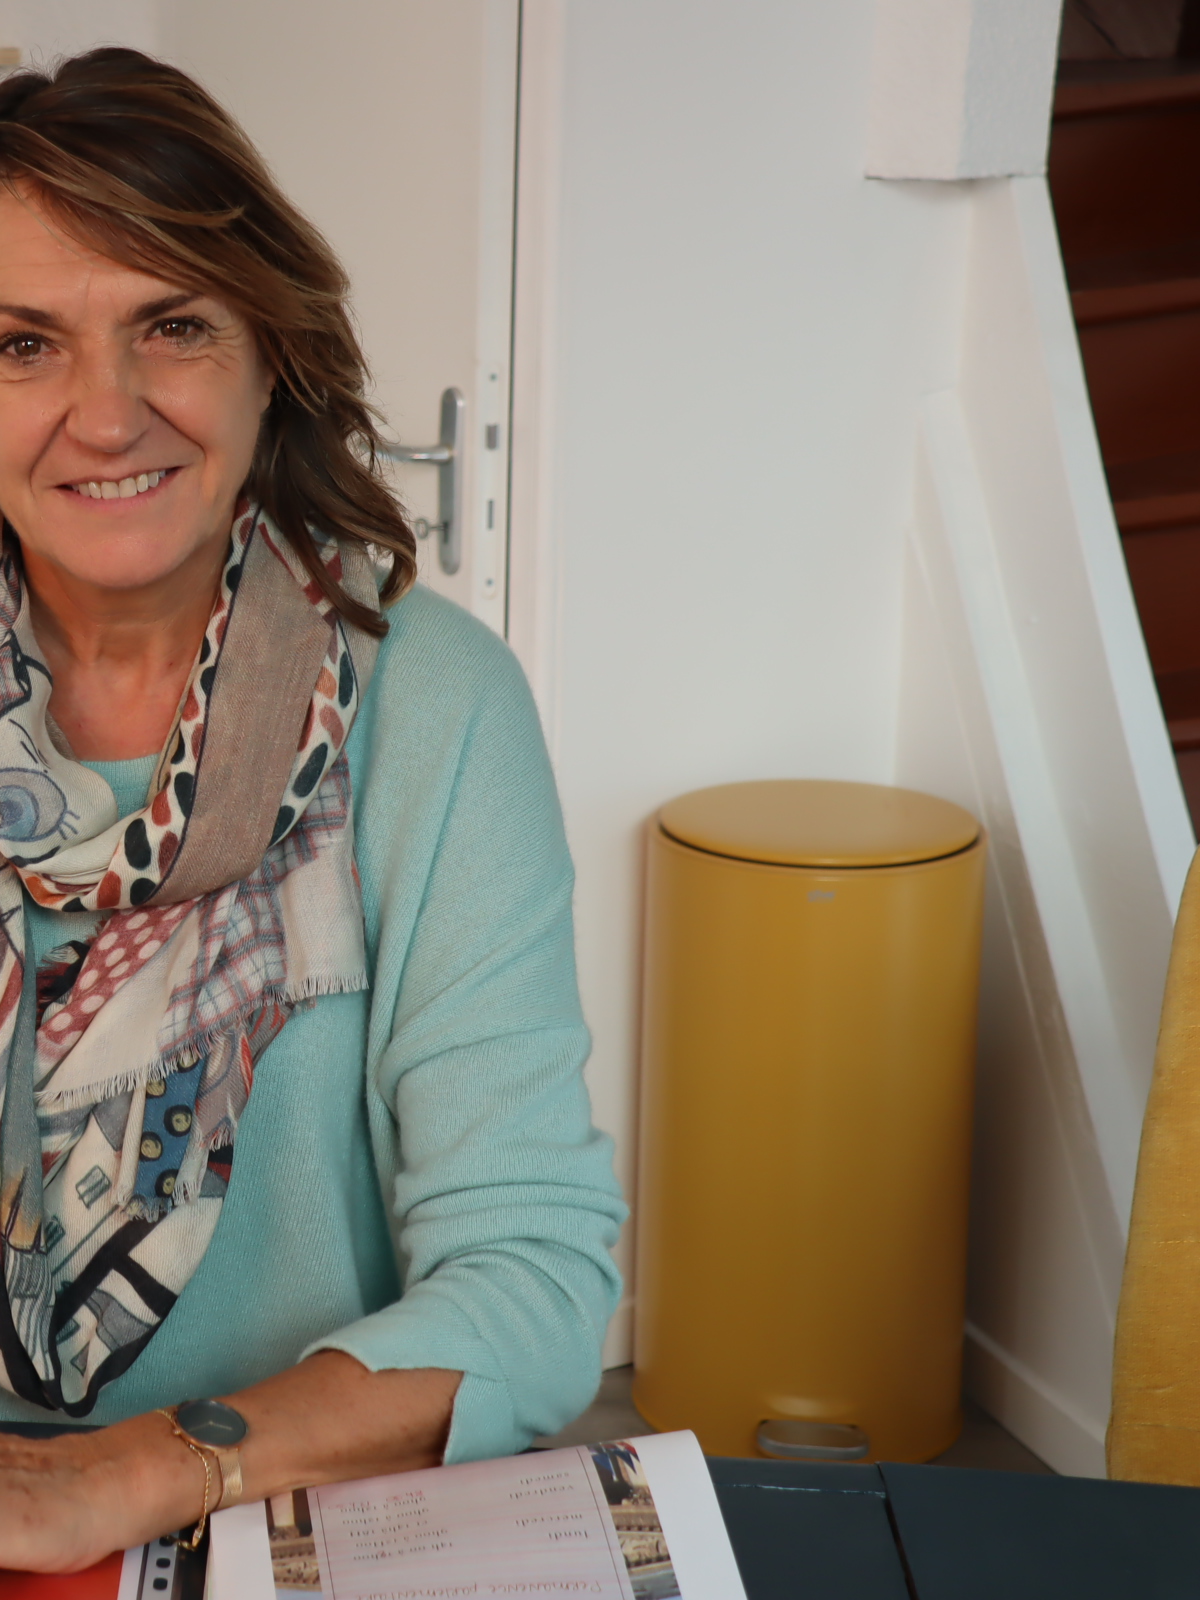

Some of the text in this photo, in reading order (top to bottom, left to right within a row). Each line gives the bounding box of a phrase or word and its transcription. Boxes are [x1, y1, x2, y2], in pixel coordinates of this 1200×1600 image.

[520, 1472, 569, 1485] samedi
[509, 1485, 574, 1500] vendredi
[516, 1514, 582, 1527] mercredi
[548, 1530, 588, 1541] lundi
